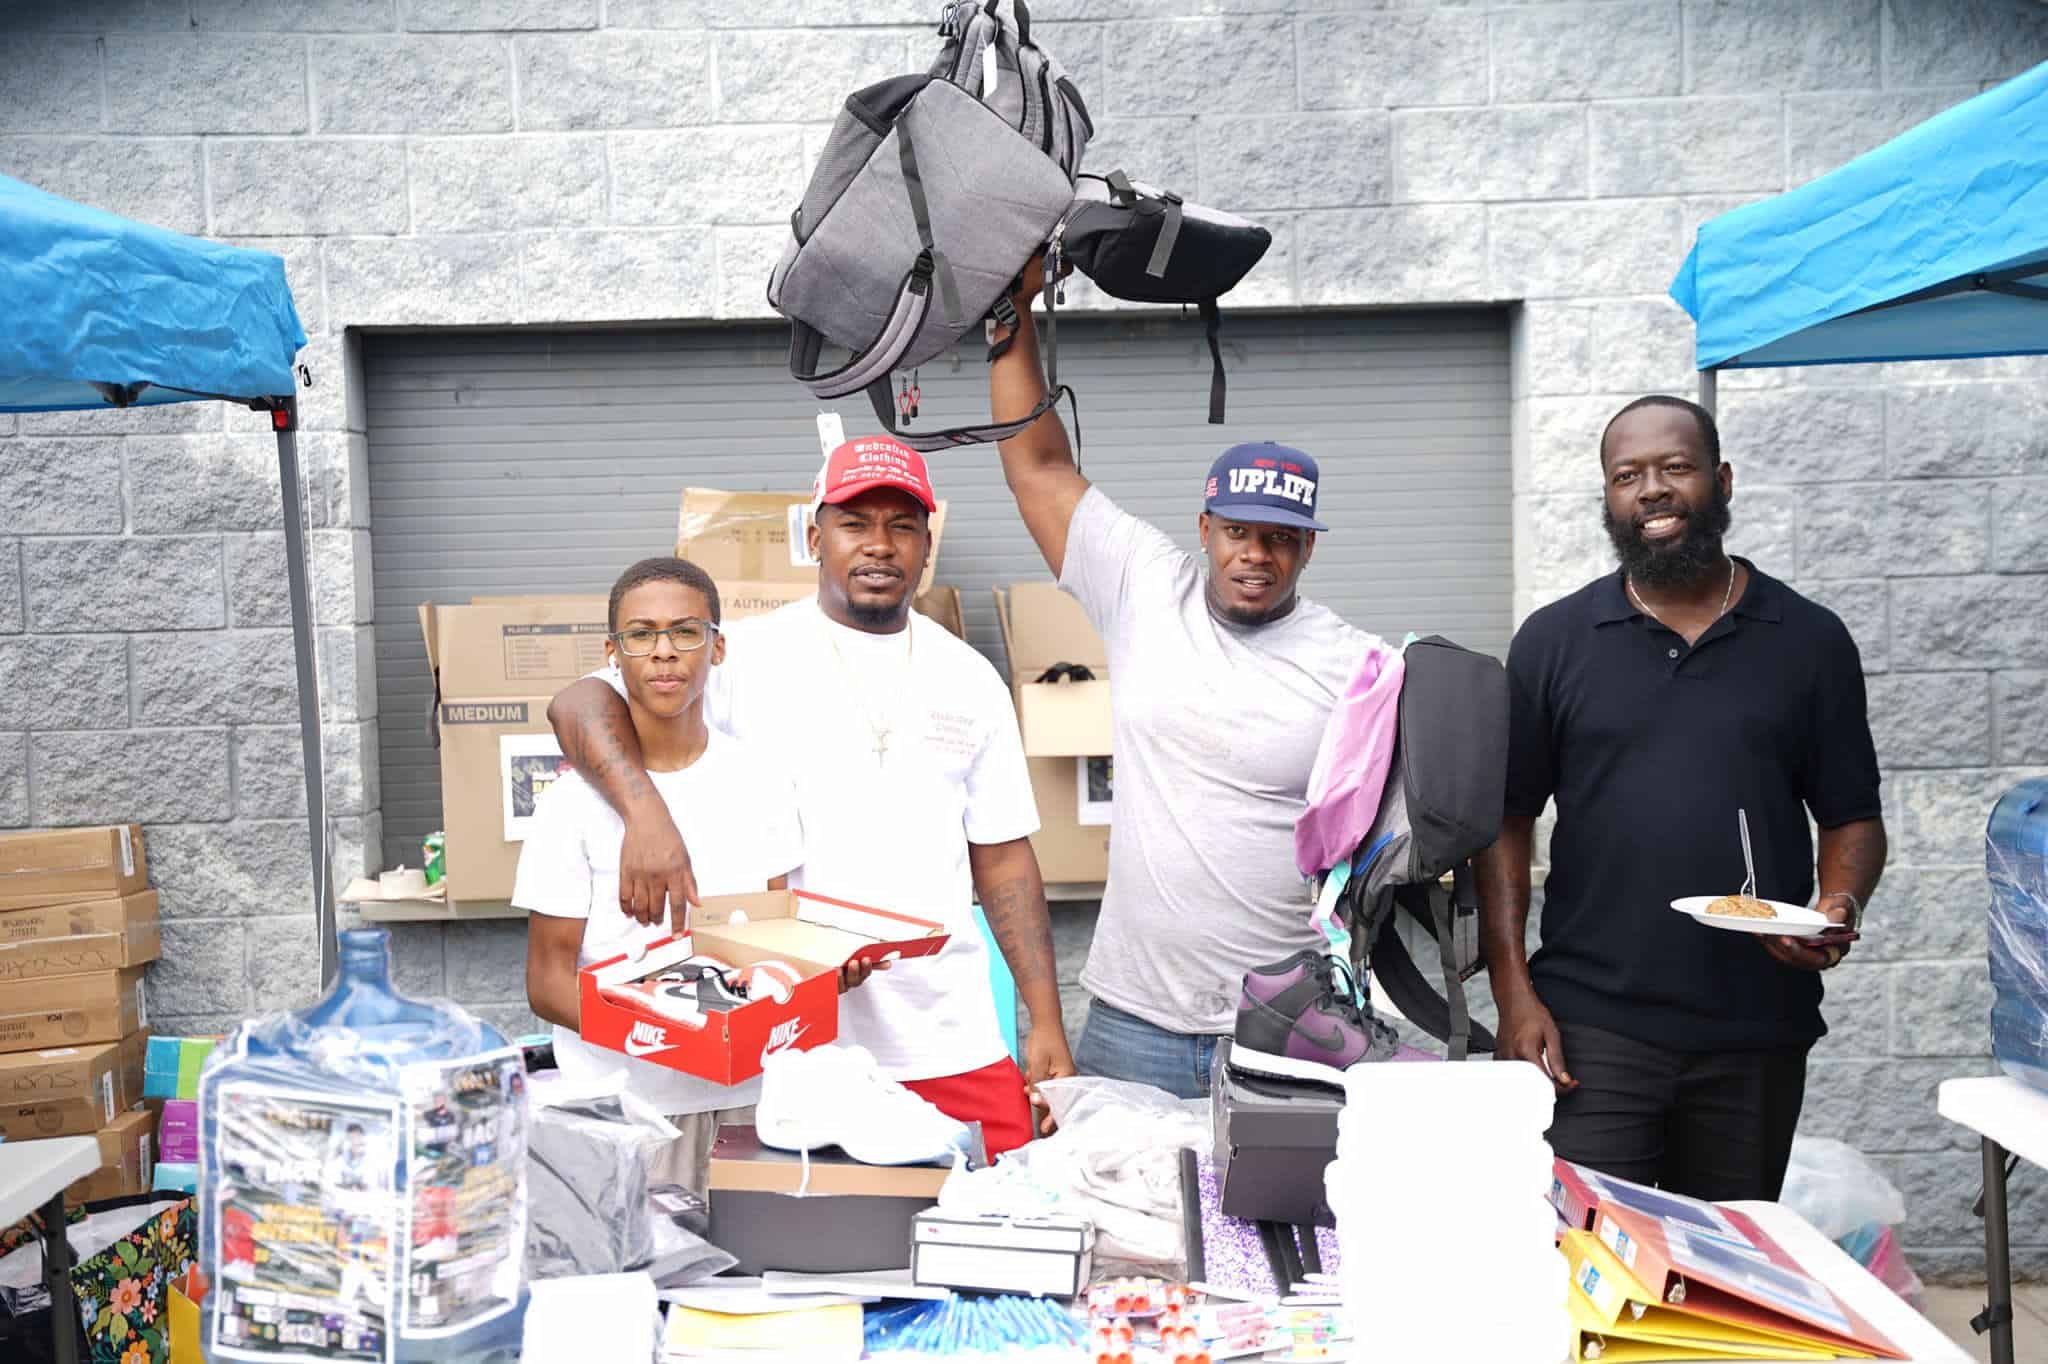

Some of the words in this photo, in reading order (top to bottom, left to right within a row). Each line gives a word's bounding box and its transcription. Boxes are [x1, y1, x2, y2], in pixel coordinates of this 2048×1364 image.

[859, 452, 908, 469] Clothing
[1229, 468, 1316, 507] UPLIFT
[449, 706, 522, 721] MEDIUM
[631, 1020, 667, 1044] NIKE
[767, 1016, 801, 1050] NIKE
